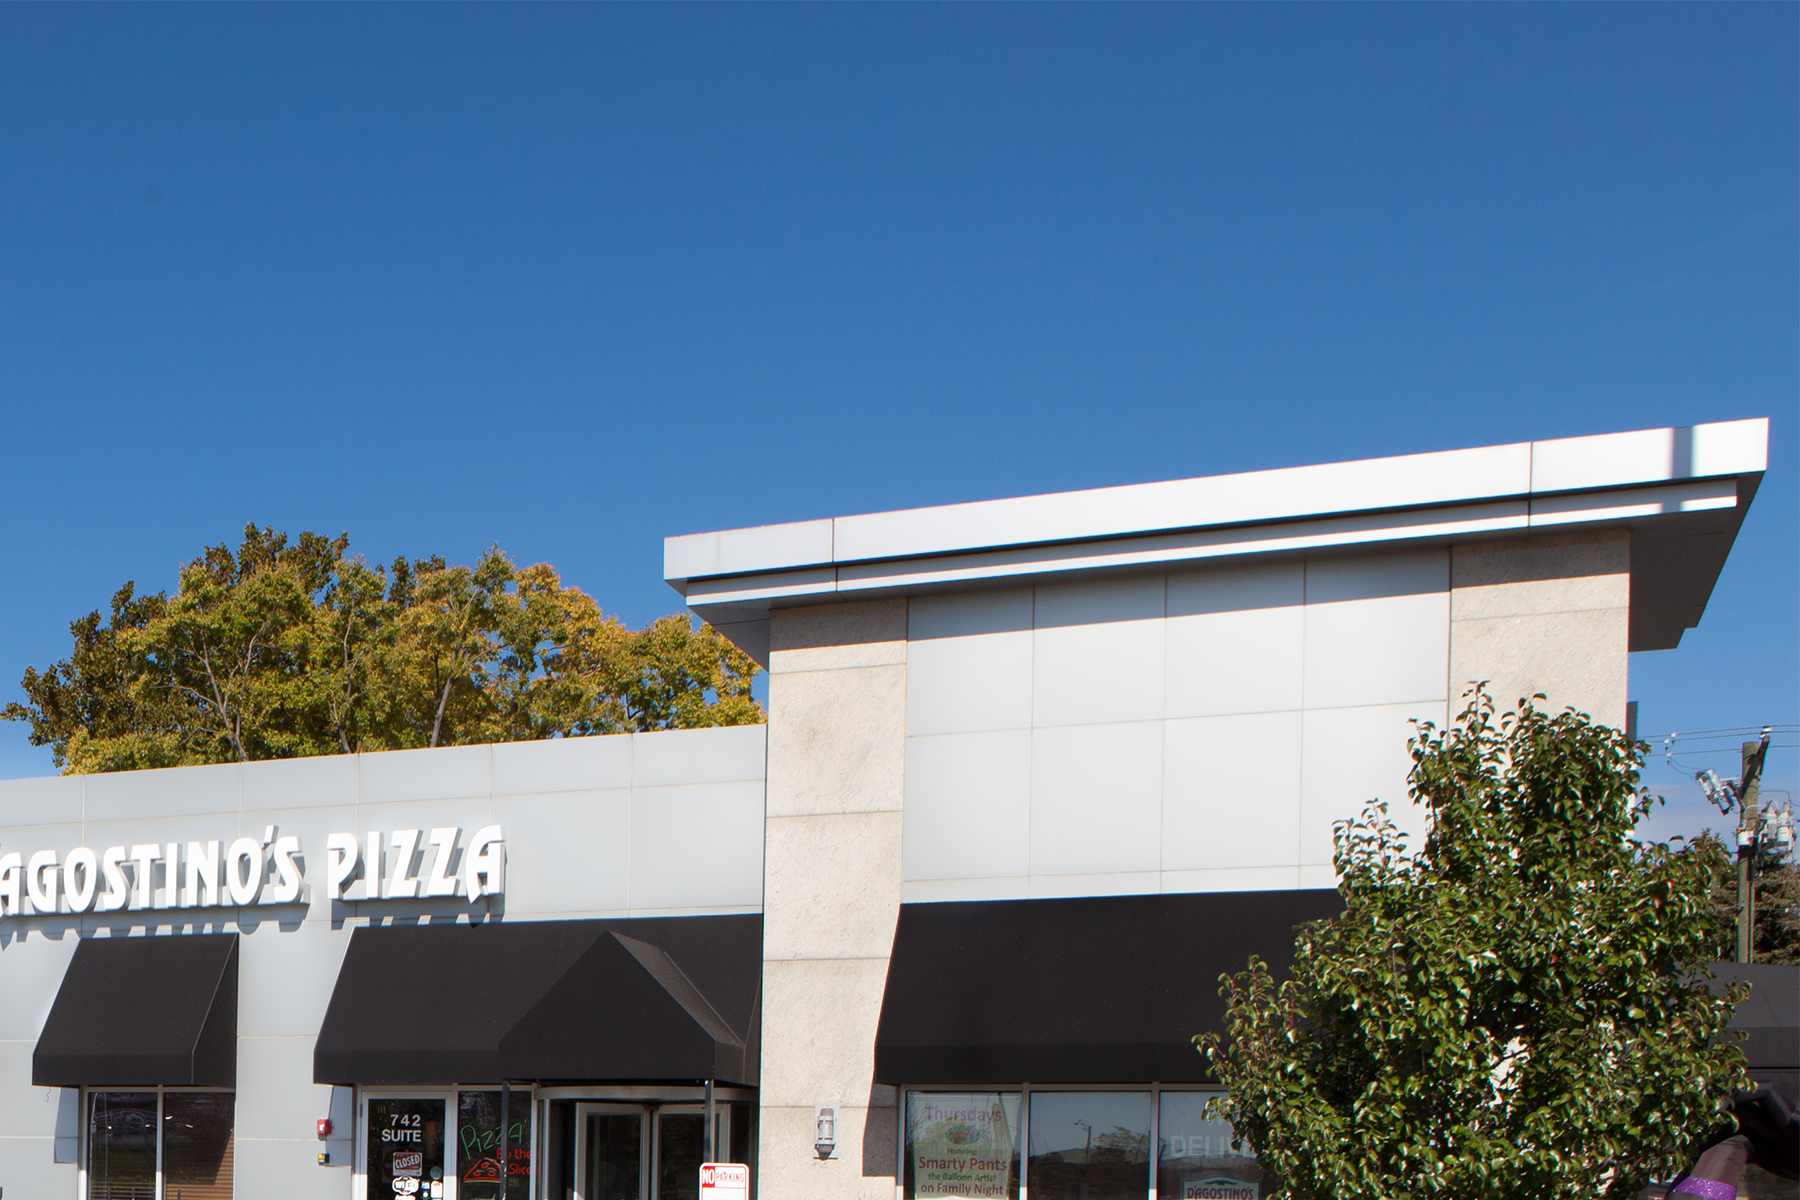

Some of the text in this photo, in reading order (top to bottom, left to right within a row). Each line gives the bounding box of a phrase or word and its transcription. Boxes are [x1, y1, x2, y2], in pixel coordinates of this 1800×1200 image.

[325, 824, 507, 904] PIZZA
[390, 1113, 421, 1127] 742
[925, 1105, 1003, 1125] Thursdays
[381, 1128, 422, 1143] SUITE
[394, 1154, 421, 1170] CLOSED
[919, 1156, 1008, 1173] Smarty Pants
[702, 1168, 745, 1185] NO PARKING
[928, 1172, 941, 1181] the
[942, 1172, 973, 1182] Balloon
[920, 1183, 1004, 1198] on Family Night
[1187, 1184, 1254, 1200] D'AGOSTINO'S
